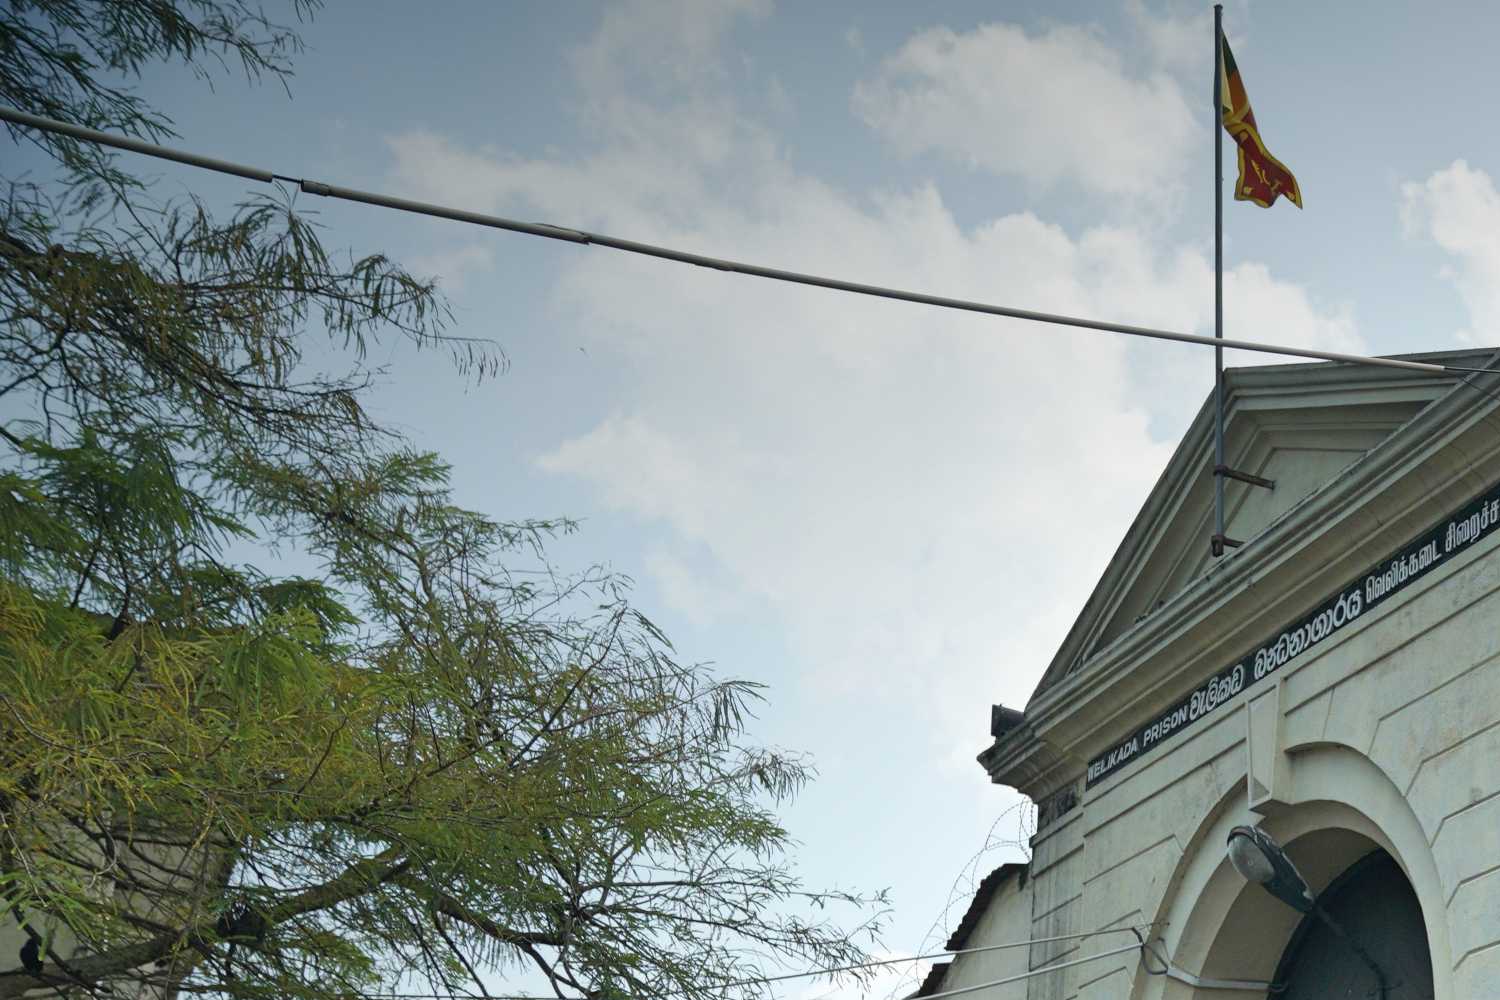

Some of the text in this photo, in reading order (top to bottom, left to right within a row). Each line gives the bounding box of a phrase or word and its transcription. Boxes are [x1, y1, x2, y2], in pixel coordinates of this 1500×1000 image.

[1365, 539, 1442, 603] வெலிக்கடை
[1087, 707, 1188, 782] WELIKADA PRISON
